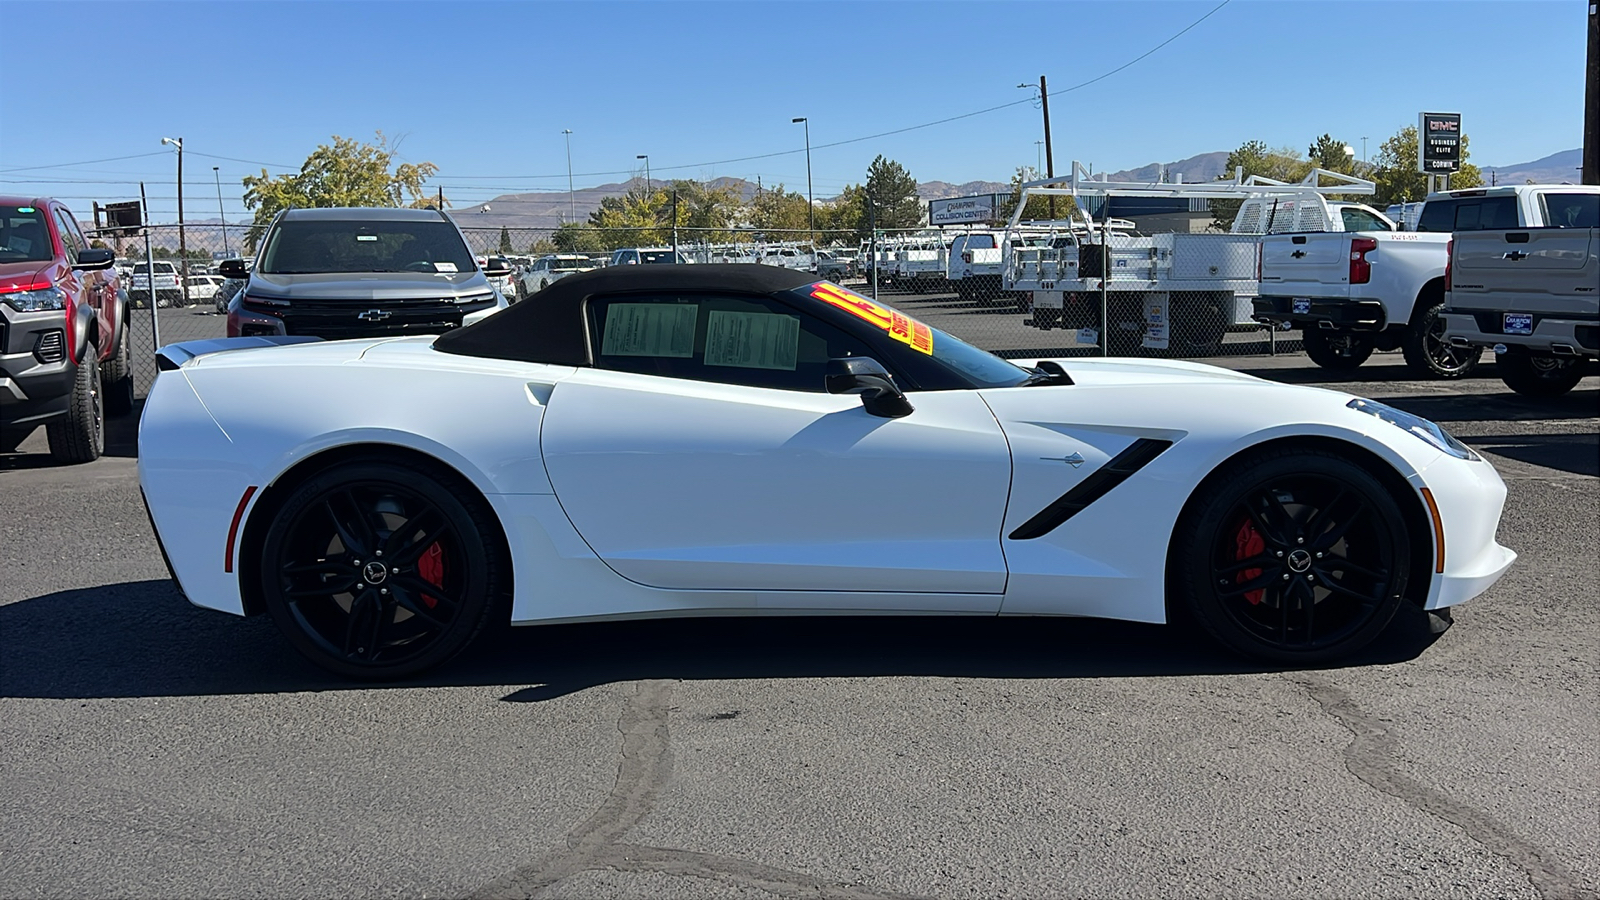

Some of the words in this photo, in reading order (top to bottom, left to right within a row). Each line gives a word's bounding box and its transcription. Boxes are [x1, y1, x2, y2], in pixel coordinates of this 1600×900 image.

[1430, 120, 1458, 131] GMC
[947, 201, 976, 213] CHAMPION
[935, 211, 964, 221] COLLISION
[1505, 316, 1531, 324] CHAMPION
